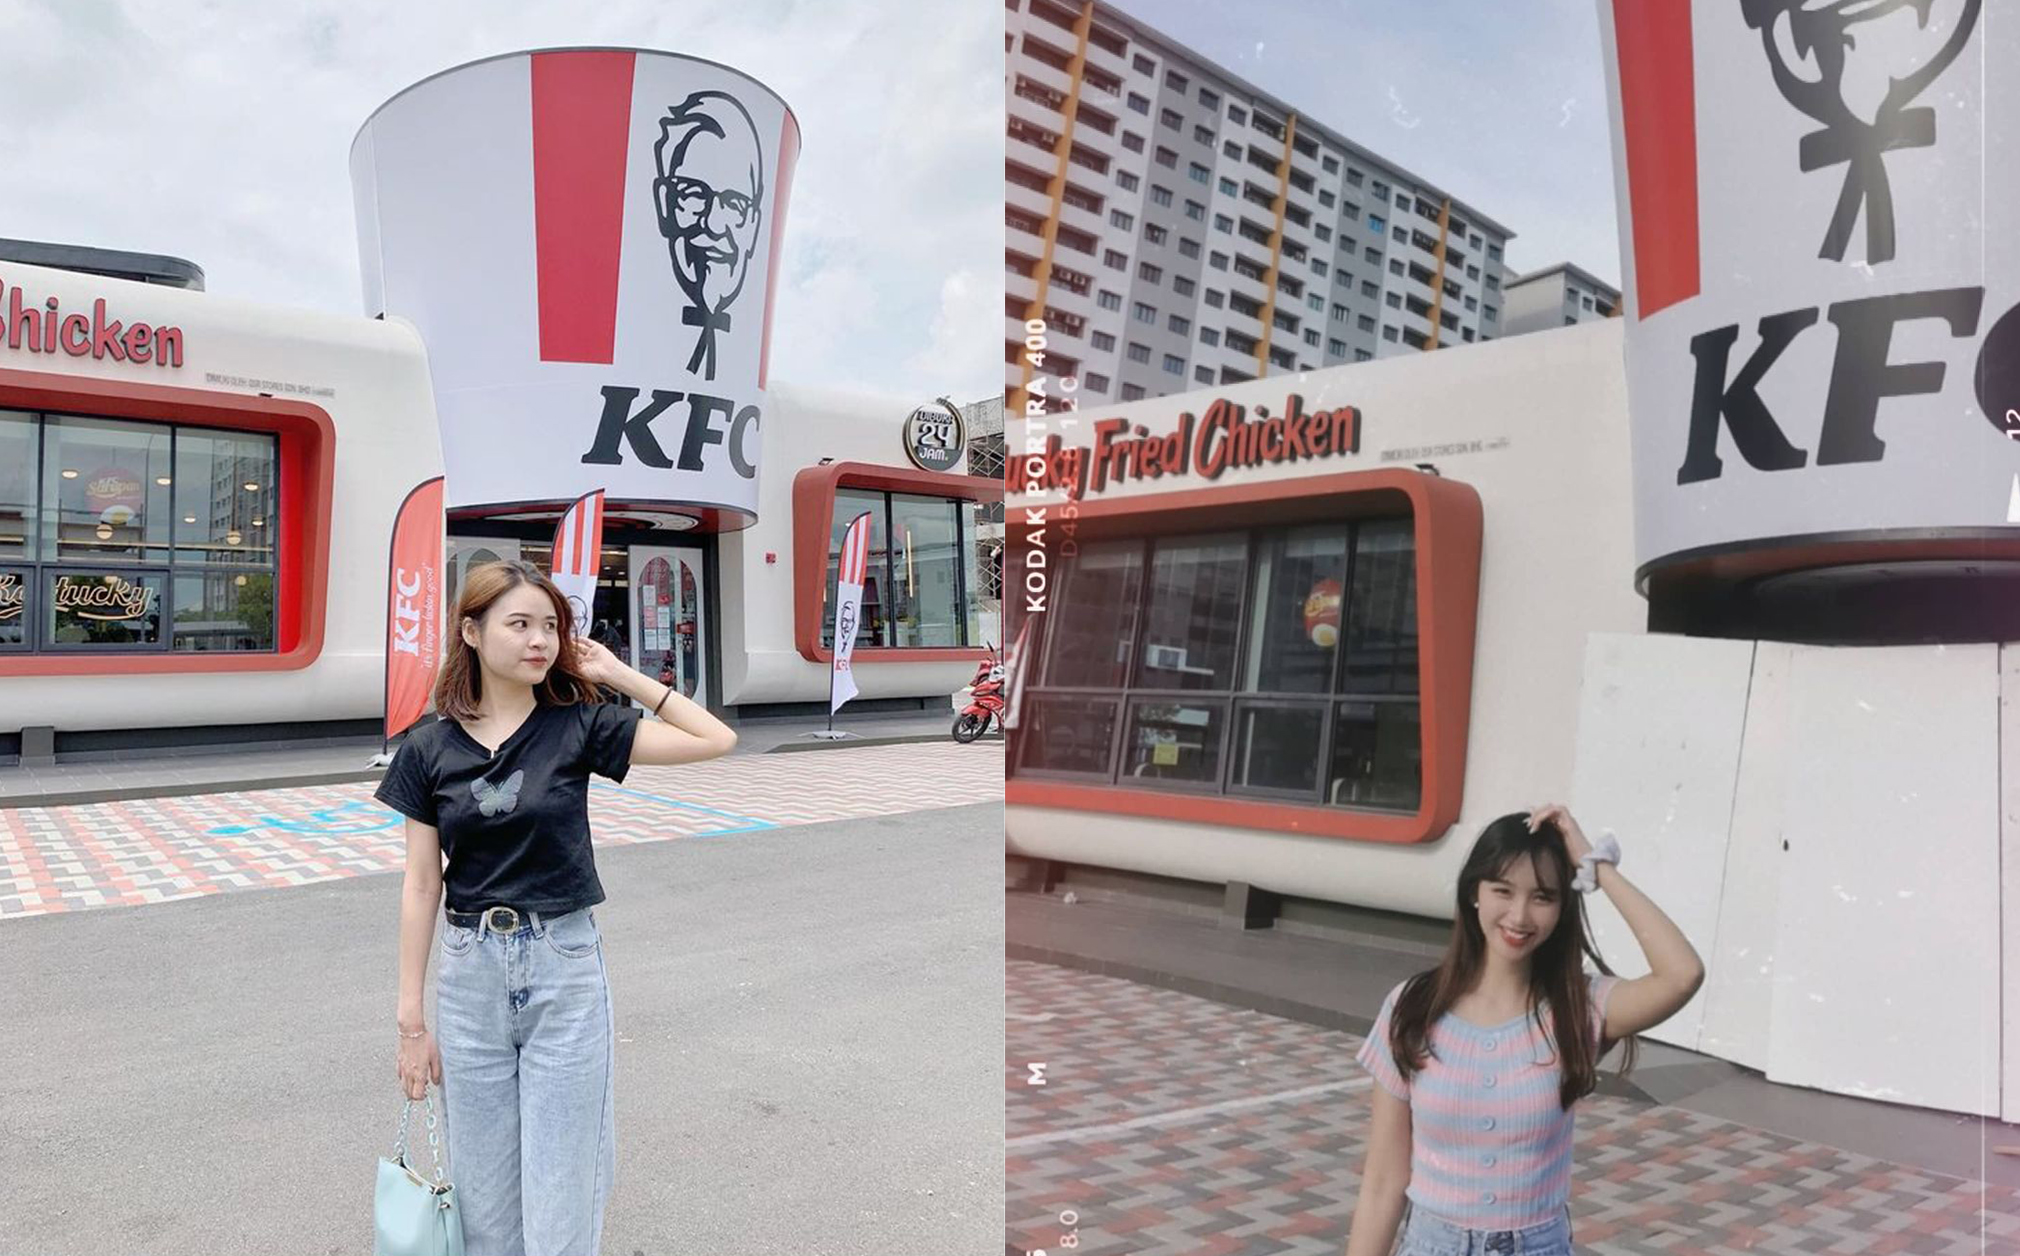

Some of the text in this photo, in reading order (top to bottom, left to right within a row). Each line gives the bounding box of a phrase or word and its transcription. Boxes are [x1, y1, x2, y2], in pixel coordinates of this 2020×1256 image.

[0, 276, 184, 368] hicken
[581, 385, 761, 479] KFC
[917, 423, 951, 448] 24
[1005, 393, 1361, 503] ucky Fried Chicken
[394, 567, 421, 657] KFC
